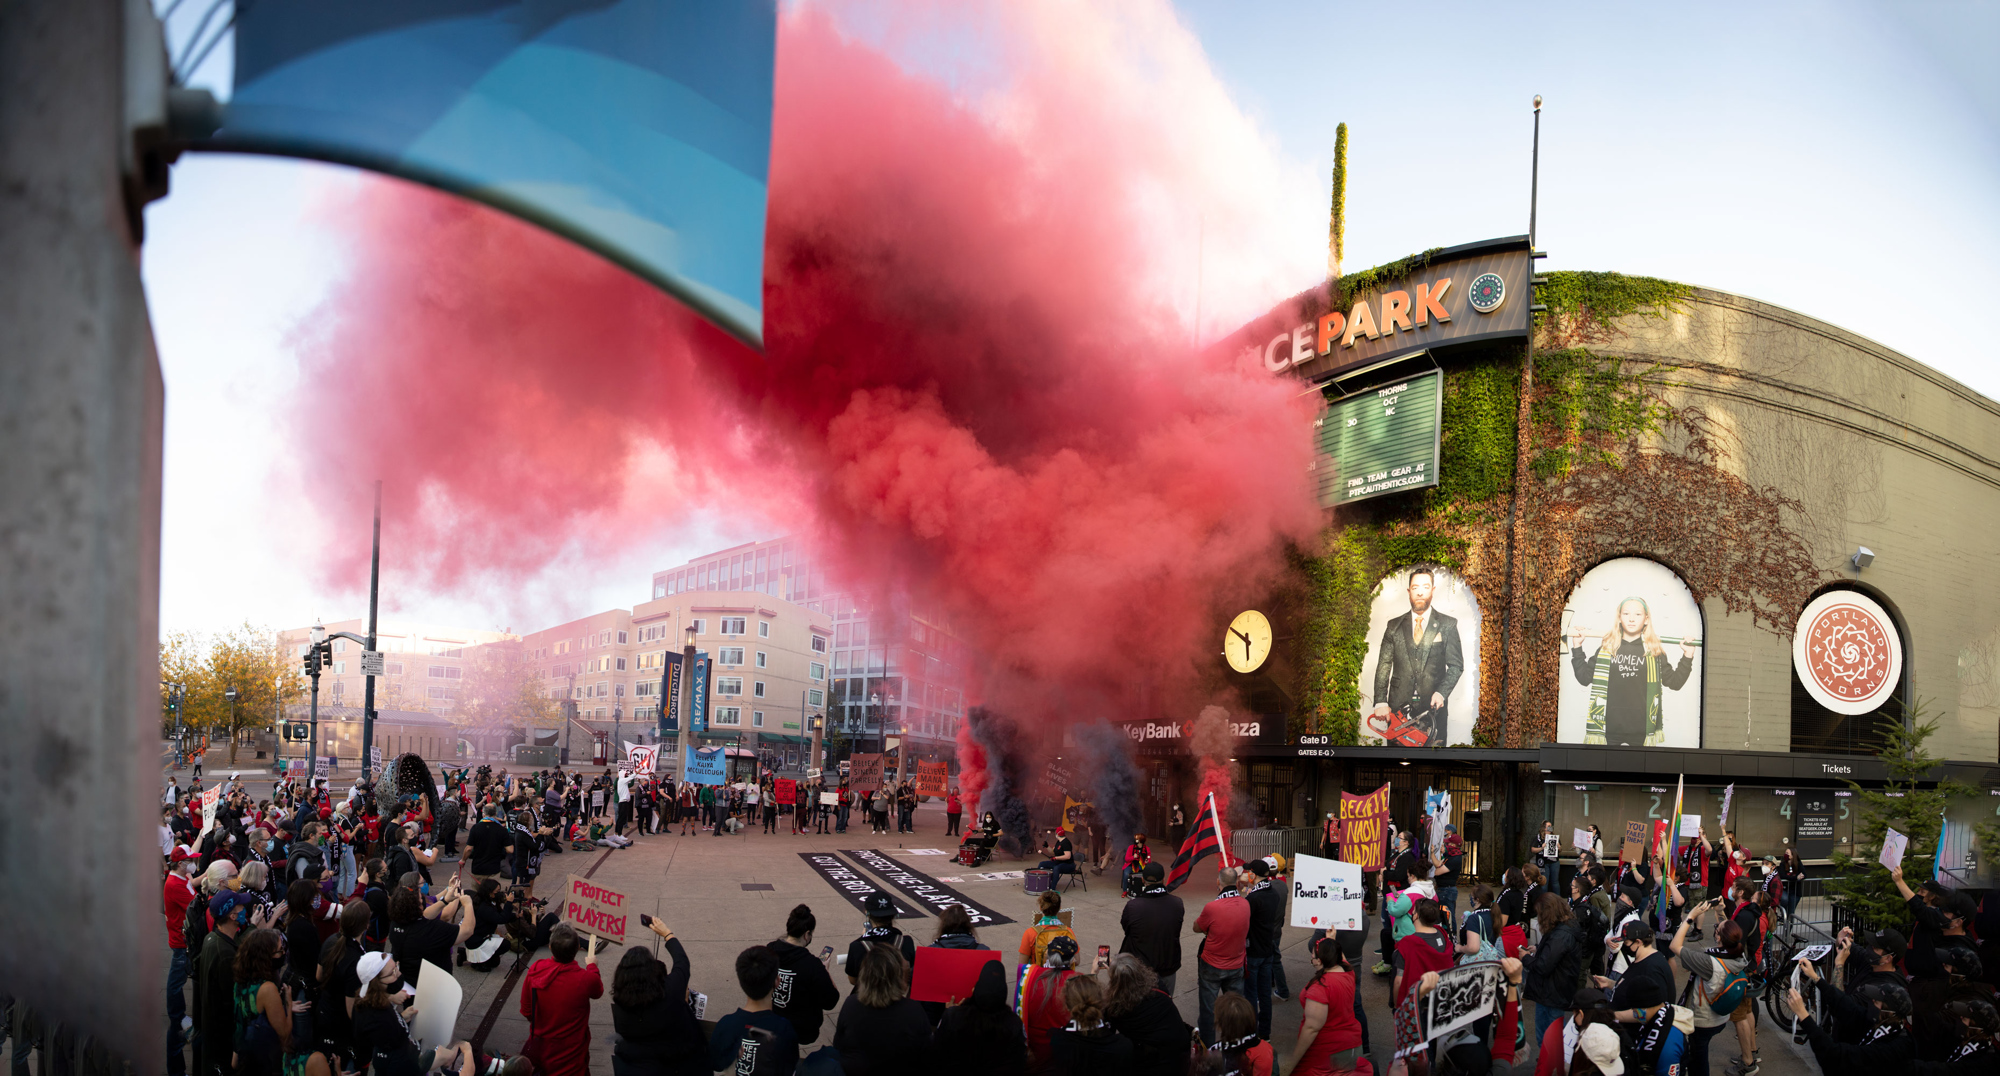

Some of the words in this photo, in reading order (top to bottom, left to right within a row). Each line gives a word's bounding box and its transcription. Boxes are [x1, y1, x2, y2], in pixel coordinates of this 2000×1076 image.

[1317, 277, 1452, 357] PARK
[1377, 383, 1408, 398] THORNS
[1382, 396, 1398, 407] OCT
[1385, 407, 1396, 417] NC
[1347, 418, 1358, 428] 30
[1347, 477, 1364, 488] FIND
[1366, 471, 1388, 484] TEAM
[1391, 466, 1412, 478] GEAR
[1415, 463, 1426, 473] AT
[1348, 474, 1425, 498] PTFCAUTHENTICS.COM
[1814, 610, 1885, 647] PORTLAND
[1610, 653, 1646, 666] WOMEN
[1618, 664, 1639, 672] BALL
[671, 662, 681, 697] DUTCH
[1815, 662, 1884, 696] THORNS
[694, 675, 704, 725] RE/MAX
[669, 697, 677, 720] BROS
[1123, 721, 1182, 743] KeyBank
[1225, 718, 1261, 738] laza
[1300, 735, 1321, 745] Gate
[1321, 736, 1329, 745] D
[695, 752, 717, 762] BELIEVE
[1298, 749, 1318, 757] GATES
[1318, 749, 1330, 757] E-G
[293, 760, 304, 769] NO
[853, 759, 879, 767] BELIEVE
[1047, 762, 1072, 778] BLACK
[1821, 763, 1852, 775] Tickets
[288, 768, 306, 777] MORE
[686, 766, 724, 776] MCCULLOUGH
[853, 768, 879, 776] SINEAD
[917, 765, 946, 776] BELIEVE
[1045, 770, 1067, 785] LIVES
[850, 776, 883, 785] FARRELLY
[920, 774, 943, 784] MANA
[1038, 777, 1068, 795] MATTER
[920, 783, 940, 792] SHIM
[1340, 787, 1388, 820] BELIEVE
[1583, 793, 1590, 817] 1
[1648, 795, 1662, 819] 2
[1779, 798, 1792, 820] 4
[1839, 798, 1850, 820] 5
[1346, 818, 1381, 844] NADIA
[1626, 829, 1646, 839] FAILED
[1627, 822, 1645, 832] YOU
[1626, 836, 1644, 846] THEM
[1343, 841, 1382, 868] NADIM
[850, 849, 901, 871] PROTECT
[885, 869, 925, 885] THE
[825, 868, 858, 882] THE
[572, 880, 625, 908] PROTECT
[839, 880, 877, 894] ROT
[568, 901, 627, 942] PLAYERS!
